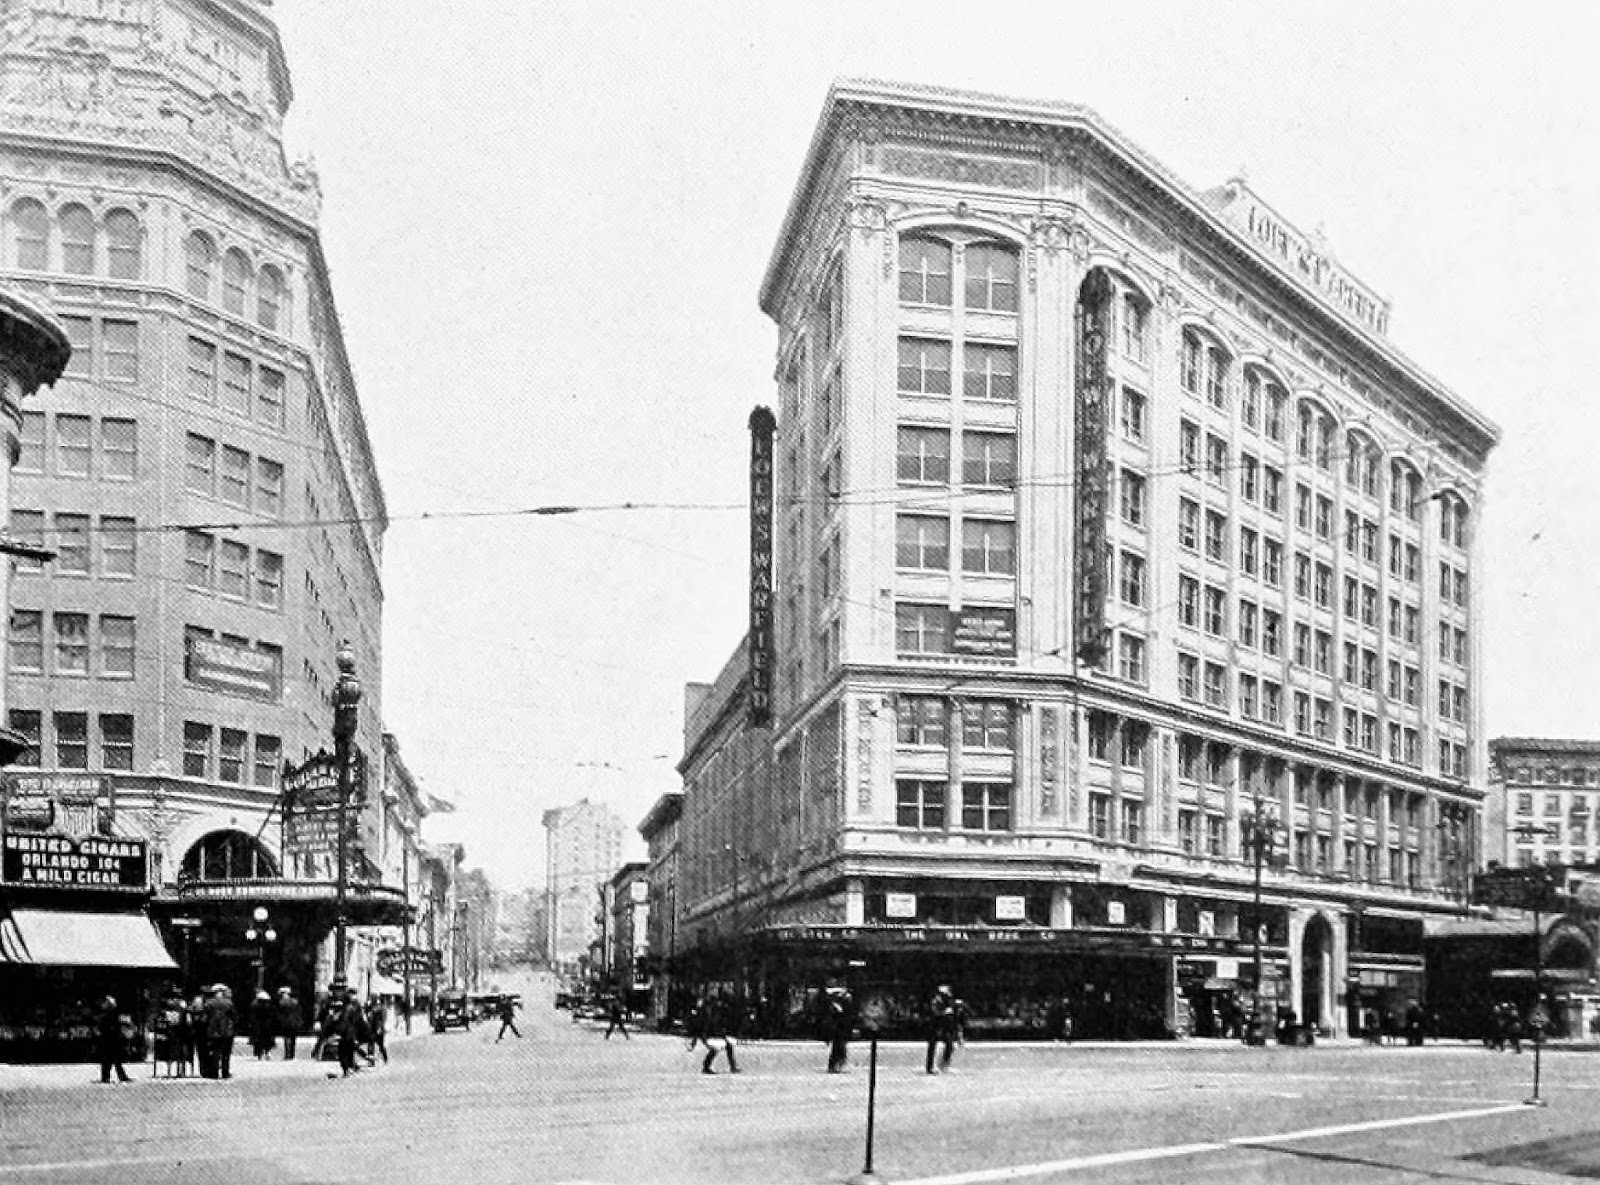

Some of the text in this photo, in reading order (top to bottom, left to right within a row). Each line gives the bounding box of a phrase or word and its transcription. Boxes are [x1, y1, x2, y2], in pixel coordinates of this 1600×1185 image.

[6, 837, 72, 853] UNITED
[22, 853, 89, 870] ORLANDO
[23, 868, 120, 883] A MILD CIGAR
